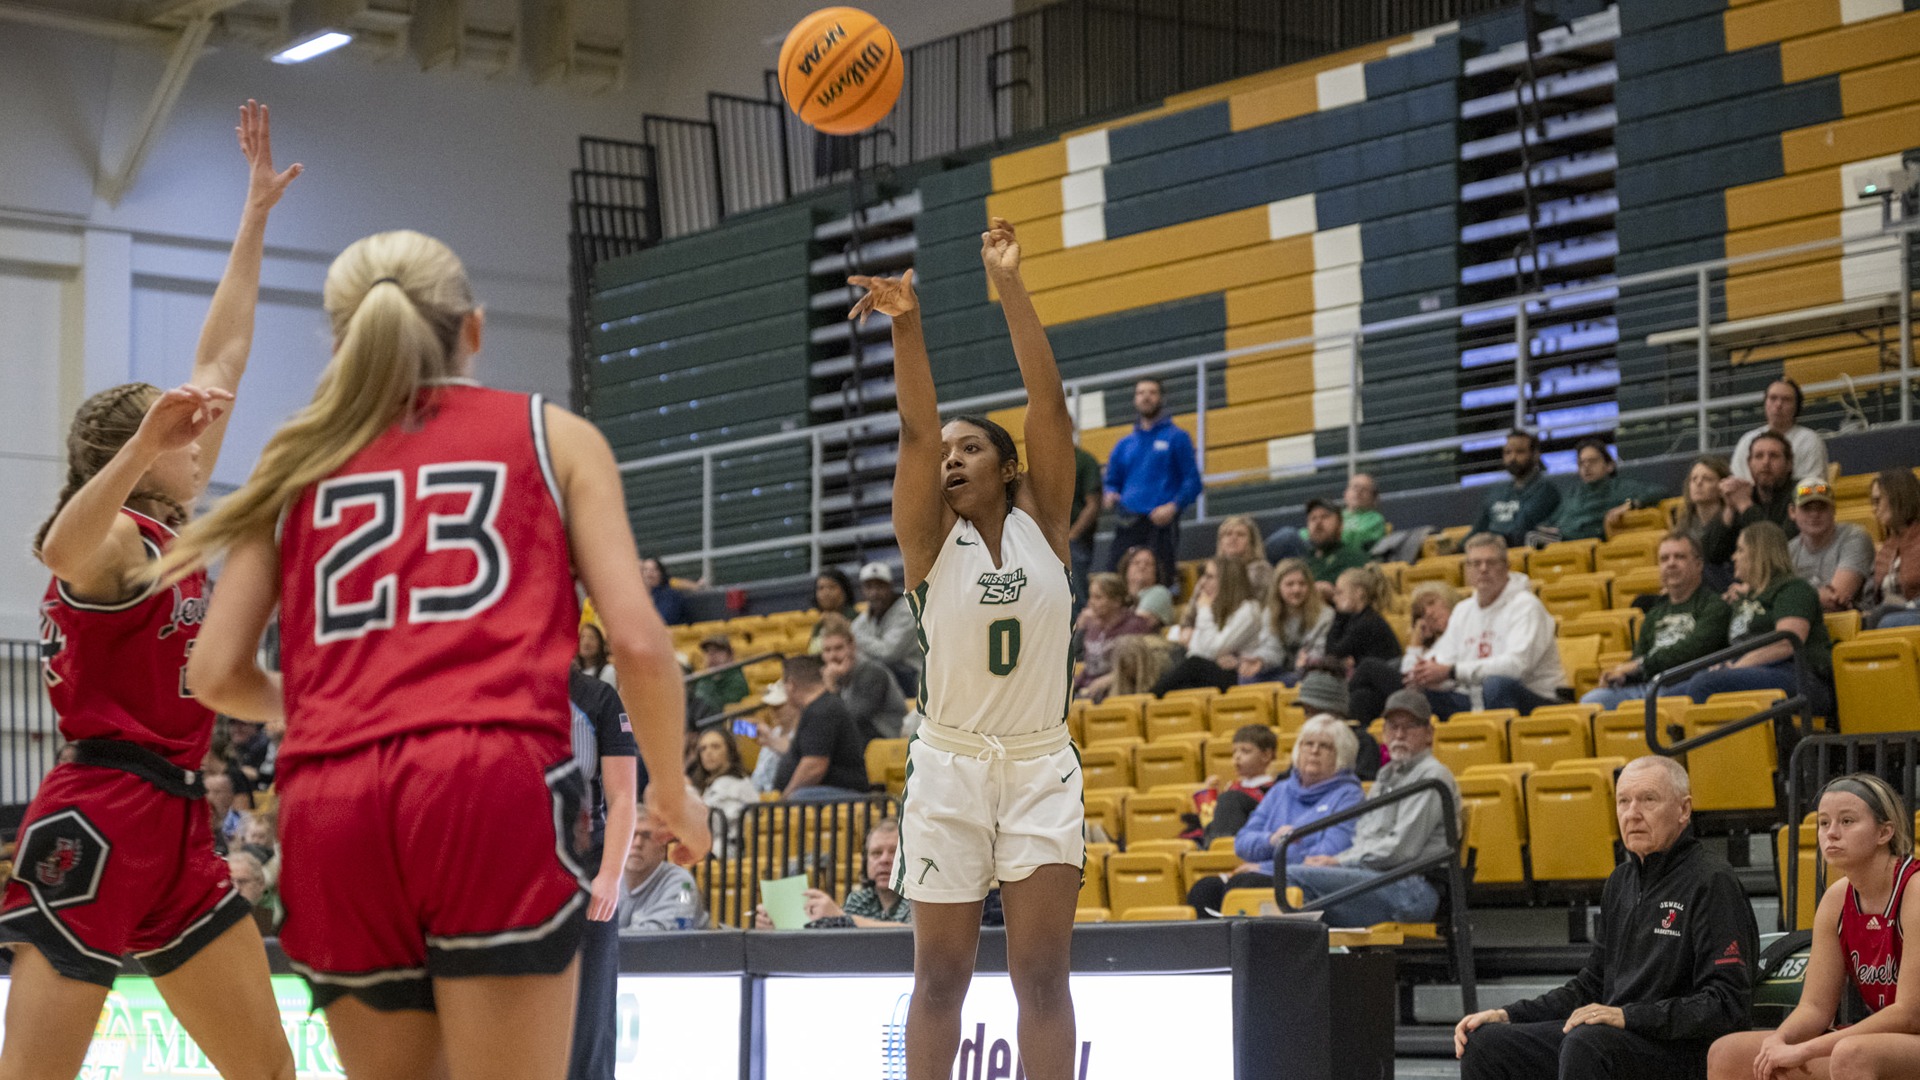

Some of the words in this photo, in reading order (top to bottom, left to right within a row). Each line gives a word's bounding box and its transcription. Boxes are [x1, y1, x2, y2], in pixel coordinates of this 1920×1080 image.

[798, 23, 846, 76] NCAA
[817, 41, 885, 107] Wilson
[313, 461, 511, 646] 23
[978, 568, 1025, 585] MISSOURI
[980, 580, 1026, 604] S&T
[988, 616, 1022, 678] 0
[1660, 901, 1684, 911] JEWELL
[1654, 928, 1681, 937] BASKETBALL
